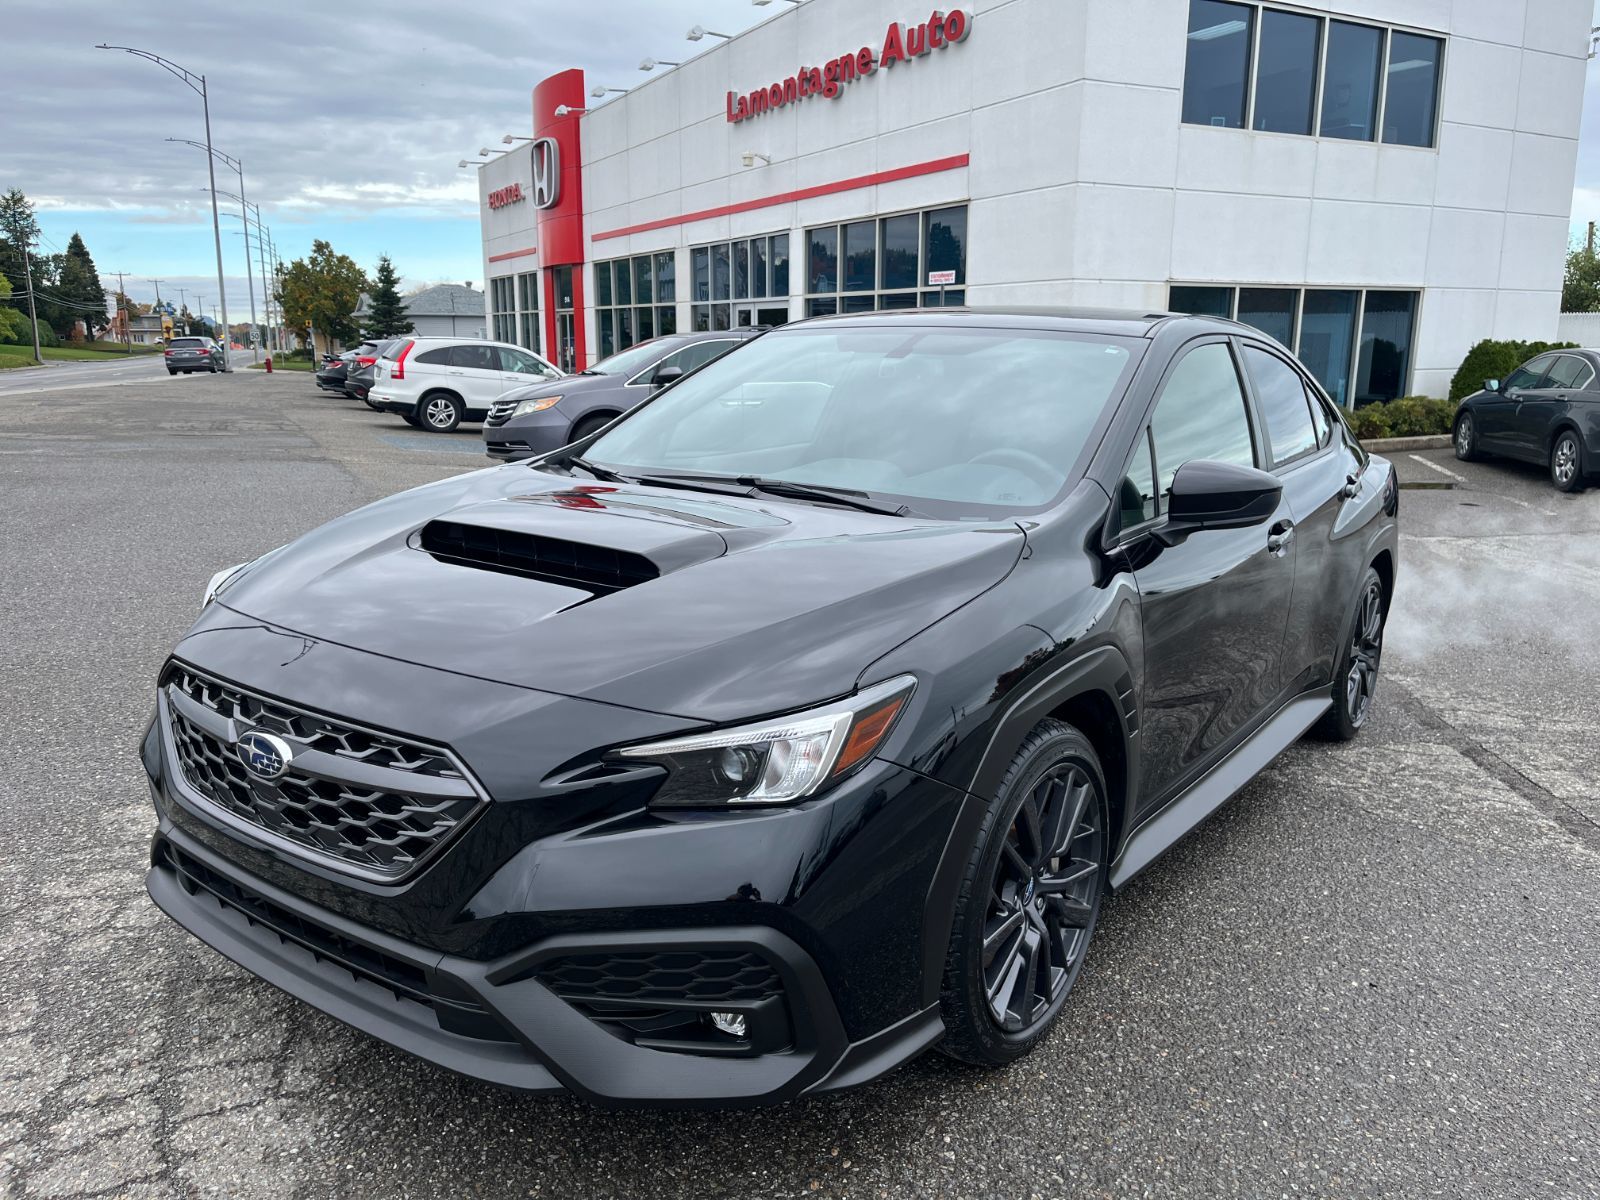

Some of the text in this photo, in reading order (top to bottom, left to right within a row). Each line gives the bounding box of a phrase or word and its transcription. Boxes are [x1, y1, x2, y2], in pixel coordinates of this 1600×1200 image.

[727, 9, 971, 123] Lamontagne Auto
[488, 183, 524, 210] HONDA
[251, 332, 259, 340] 50
